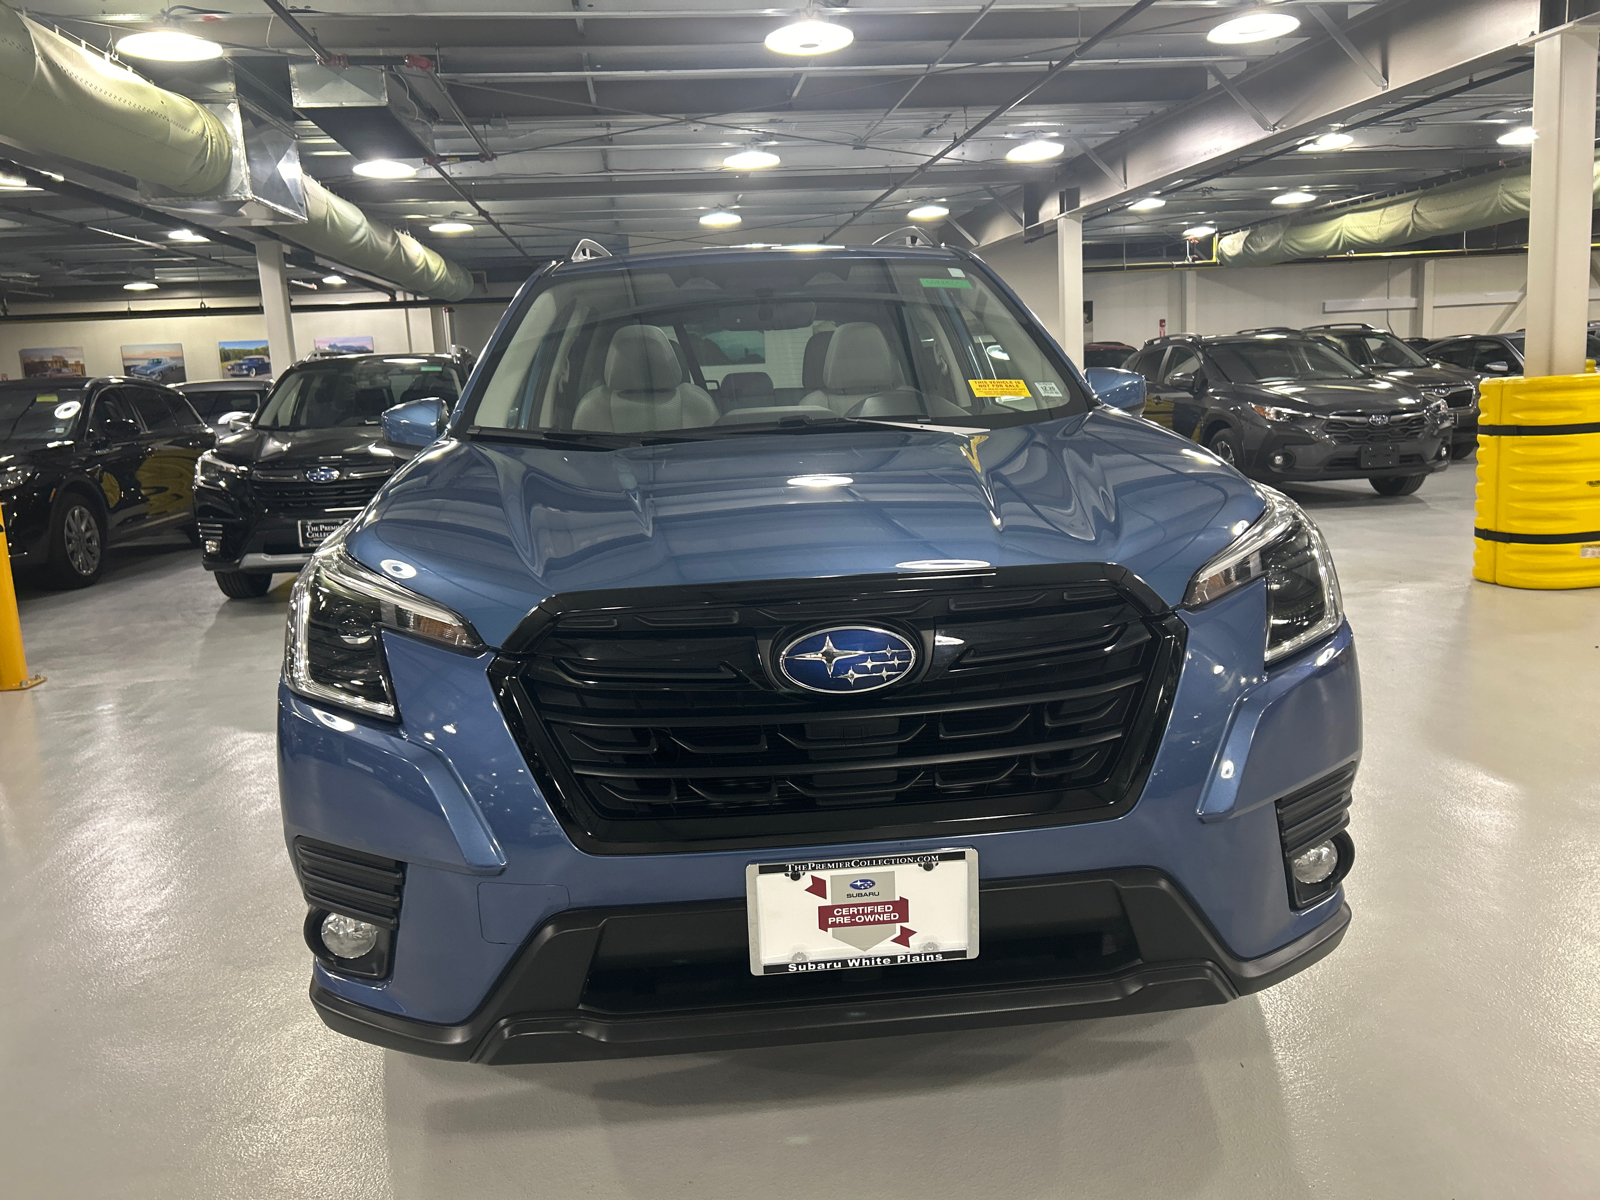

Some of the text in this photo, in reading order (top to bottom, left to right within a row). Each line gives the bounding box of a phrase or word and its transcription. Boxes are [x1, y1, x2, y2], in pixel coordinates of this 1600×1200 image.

[833, 904, 893, 916] CERTIFIED
[828, 912, 899, 925] PRE-OWNED
[788, 952, 943, 972] Subaru White Plains
